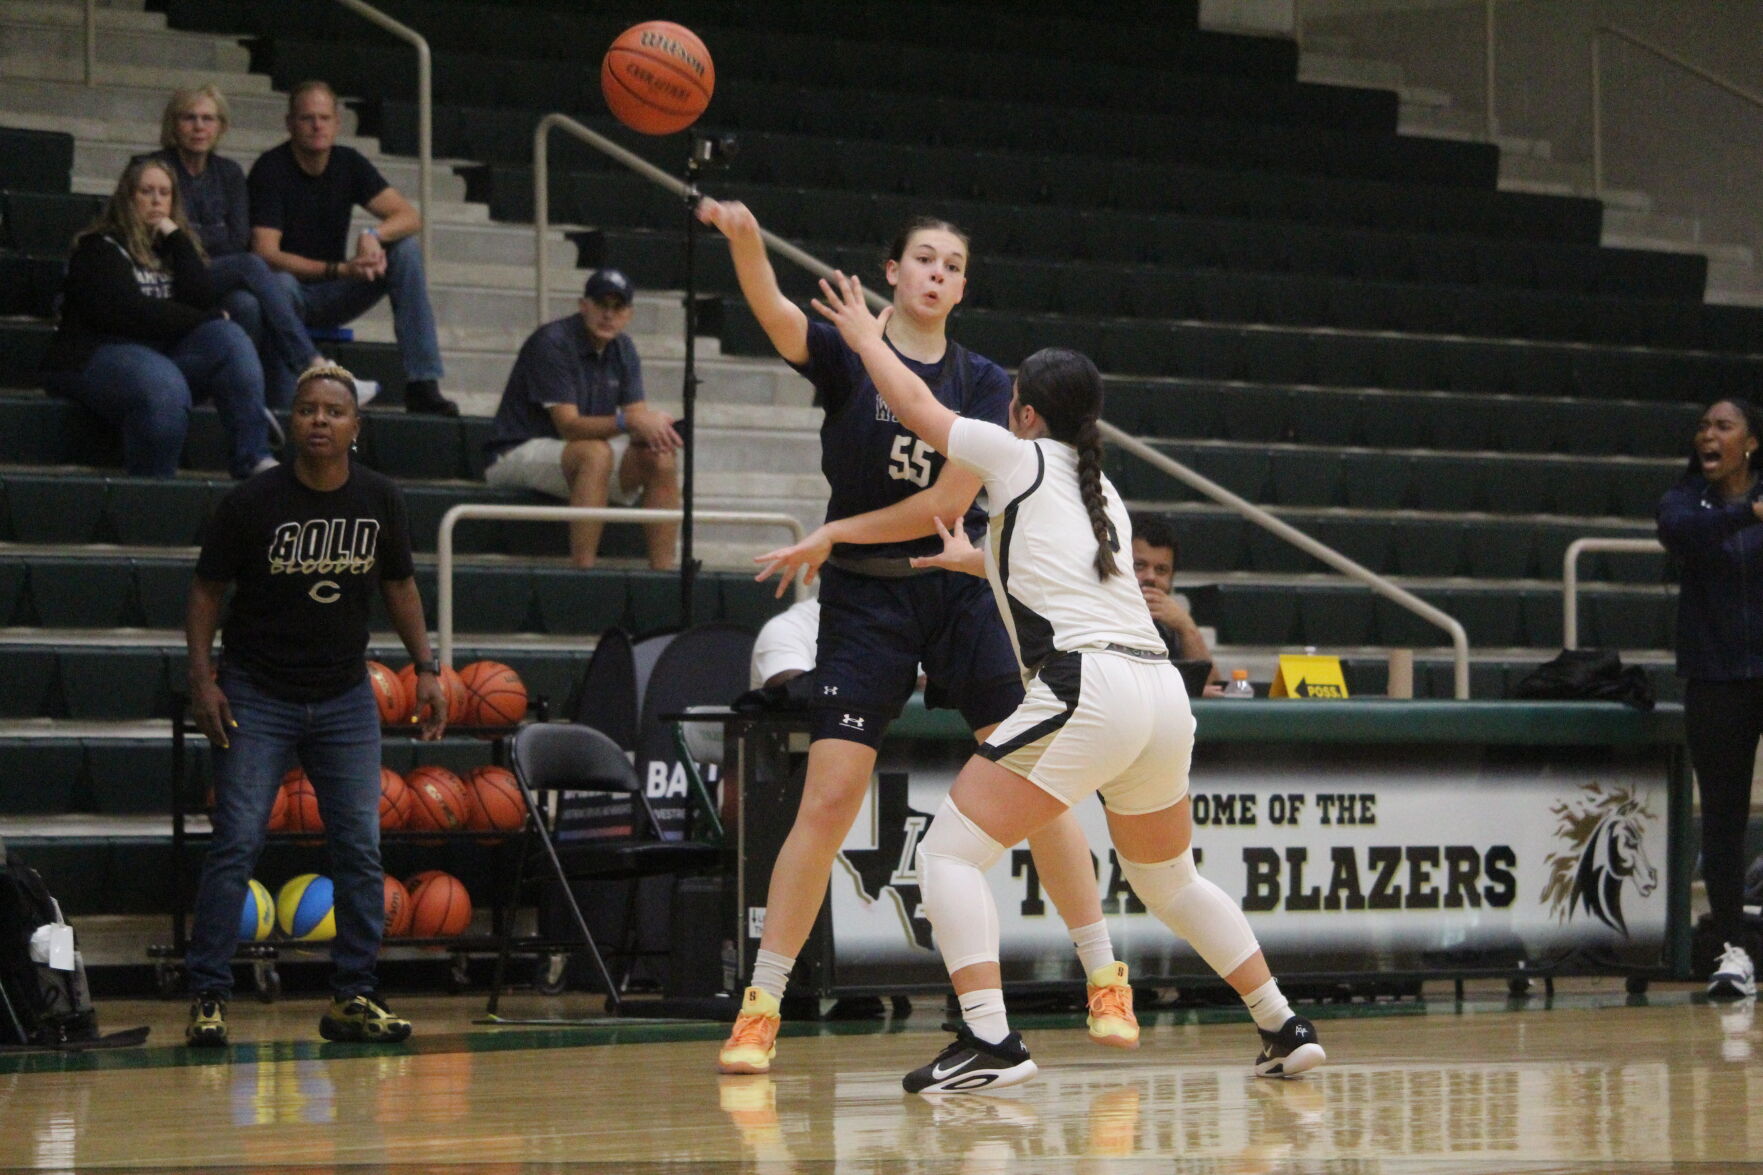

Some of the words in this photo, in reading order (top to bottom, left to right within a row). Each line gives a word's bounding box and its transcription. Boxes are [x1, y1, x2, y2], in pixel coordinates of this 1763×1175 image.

[888, 434, 936, 488] 55
[268, 518, 380, 566] GOLD
[308, 580, 341, 604] C
[1189, 793, 1256, 826] OME
[1268, 793, 1305, 826] OF
[1315, 793, 1376, 826] THE
[1241, 845, 1518, 912] BLAZERS
